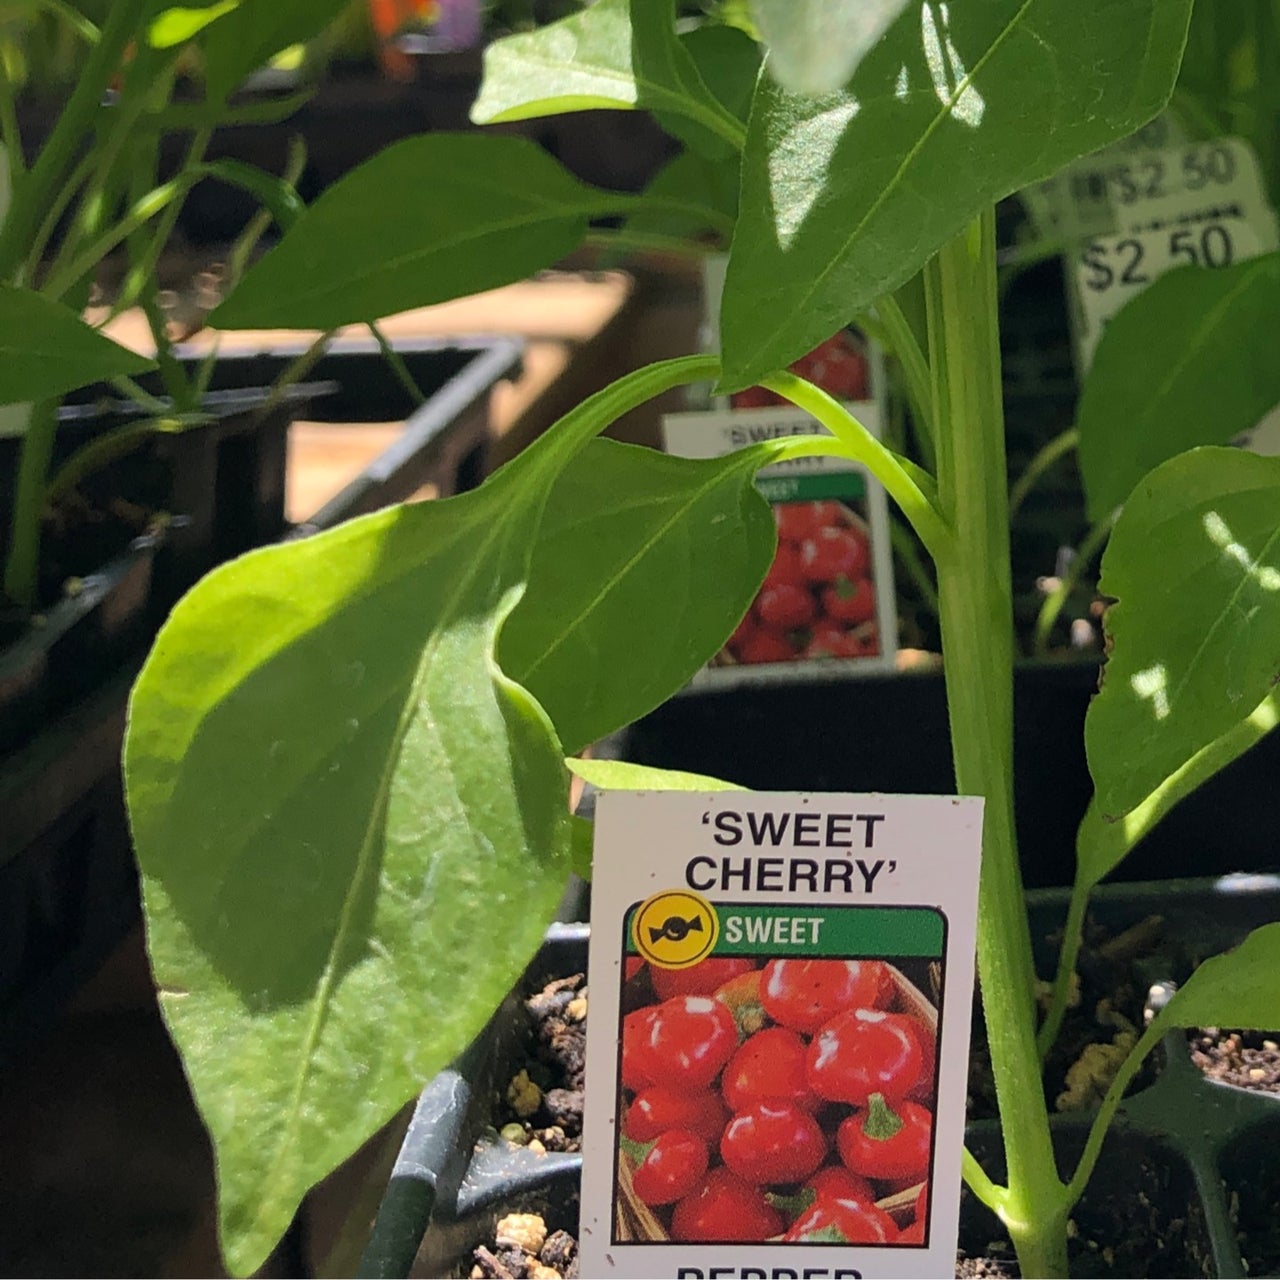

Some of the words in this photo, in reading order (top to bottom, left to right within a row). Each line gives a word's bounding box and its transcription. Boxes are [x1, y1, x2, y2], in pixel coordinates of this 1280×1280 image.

[702, 811, 885, 848] 'SWEET
[685, 855, 897, 894] CHERRY'
[725, 916, 825, 945] SWEET
